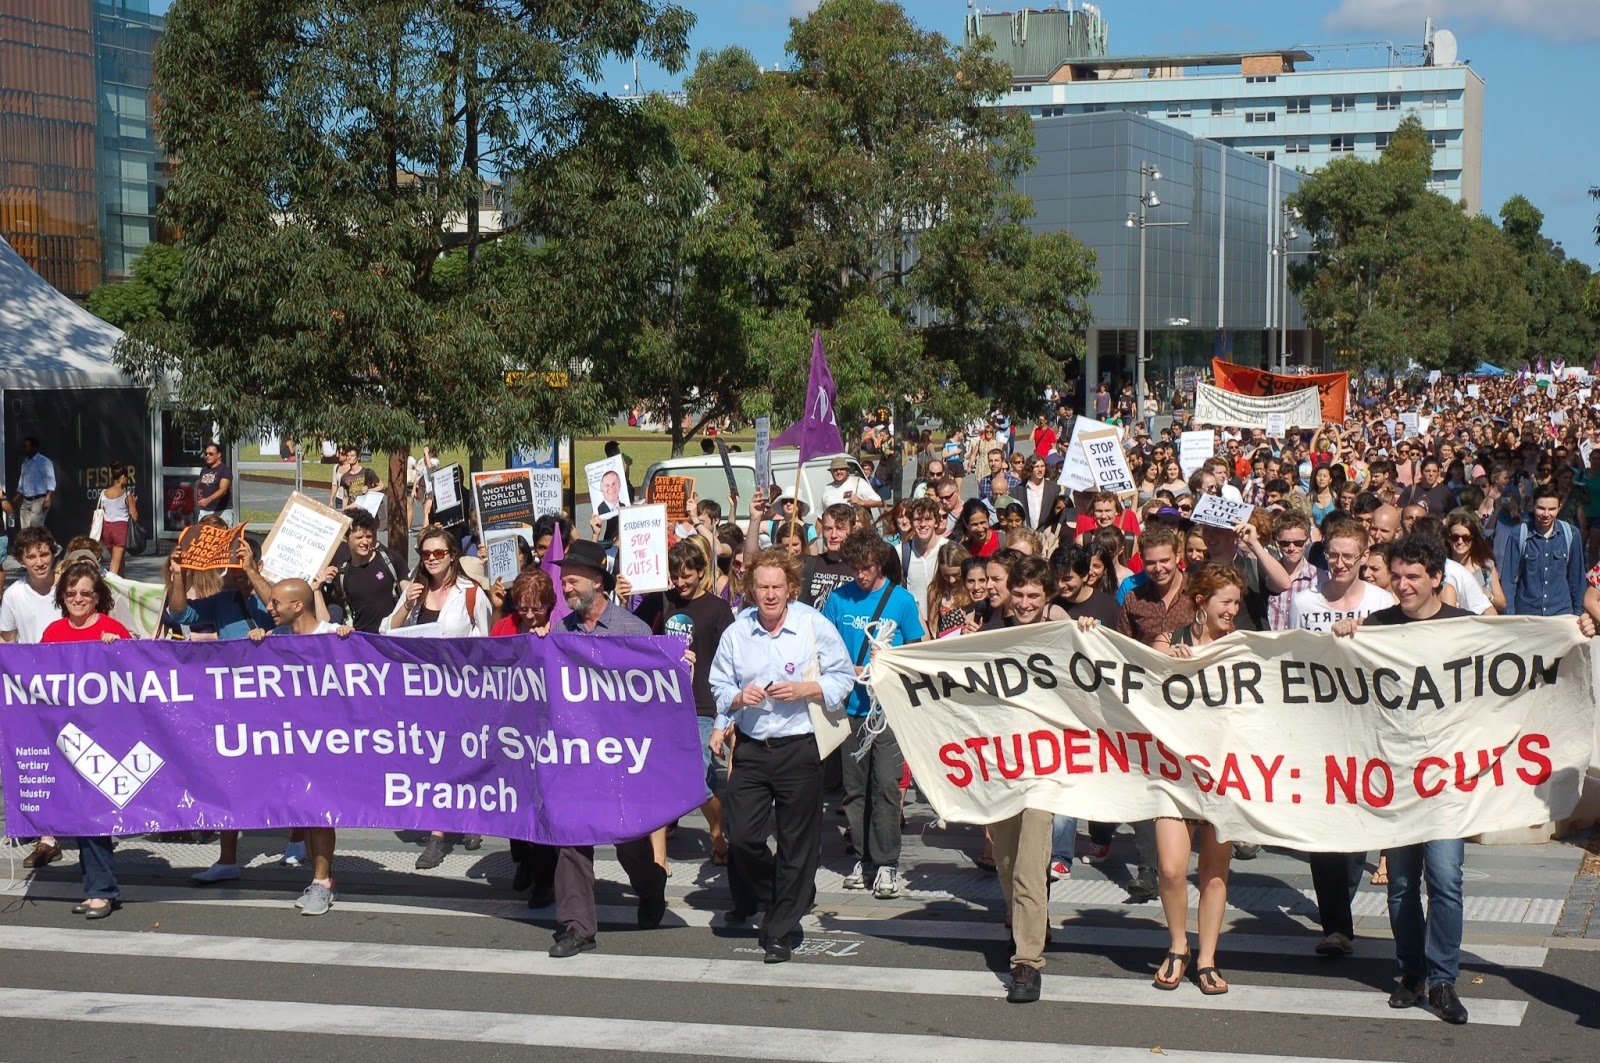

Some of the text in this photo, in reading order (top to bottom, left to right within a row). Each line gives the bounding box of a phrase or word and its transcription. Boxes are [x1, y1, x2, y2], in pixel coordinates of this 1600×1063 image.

[1196, 404, 1214, 420] JOB
[1216, 406, 1242, 422] CUTS
[1301, 408, 1316, 423] UP!
[1090, 441, 1114, 455] STOP
[1096, 456, 1116, 468] THE
[86, 465, 136, 488] FISR
[533, 473, 562, 482] DENTS
[655, 477, 685, 485] SAVE THE
[1100, 469, 1125, 482] CUTS
[481, 482, 524, 496] ANOTHER
[534, 481, 548, 489] AY:
[656, 484, 683, 492] REFUGEE
[482, 488, 526, 502] WORLD IS
[535, 490, 558, 498] HERS
[652, 492, 685, 500] LANGUAGE
[484, 495, 528, 508] POSSIBLE
[537, 498, 550, 506] OT
[653, 499, 684, 507] PRRAM!
[1209, 497, 1248, 509] STOP
[1210, 503, 1239, 514] THE
[487, 513, 500, 523] JOIN
[1203, 509, 1243, 522] CUTS
[623, 518, 662, 531] STUDENTS SAY
[281, 526, 307, 543] BUDGET
[306, 537, 326, 551] CRISIS
[631, 533, 651, 547] STOP
[277, 543, 313, 564] CORPORE
[633, 549, 647, 560] THE
[492, 559, 511, 576] STAFF
[668, 620, 693, 632] BEAT
[2, 662, 682, 706] NATIONAL TERTIARY EDUCATION UNION
[900, 651, 1563, 711] HANDS OFF OUR EDUCATION
[16, 746, 51, 756] National
[214, 721, 652, 774] University of Sydney
[17, 760, 49, 771] Tertiary
[938, 728, 1552, 808] STUDENTS SAY: NO CUTS
[19, 774, 56, 784] Education
[20, 788, 51, 800] Industry
[384, 773, 518, 813] Branch
[20, 803, 40, 812] Union
